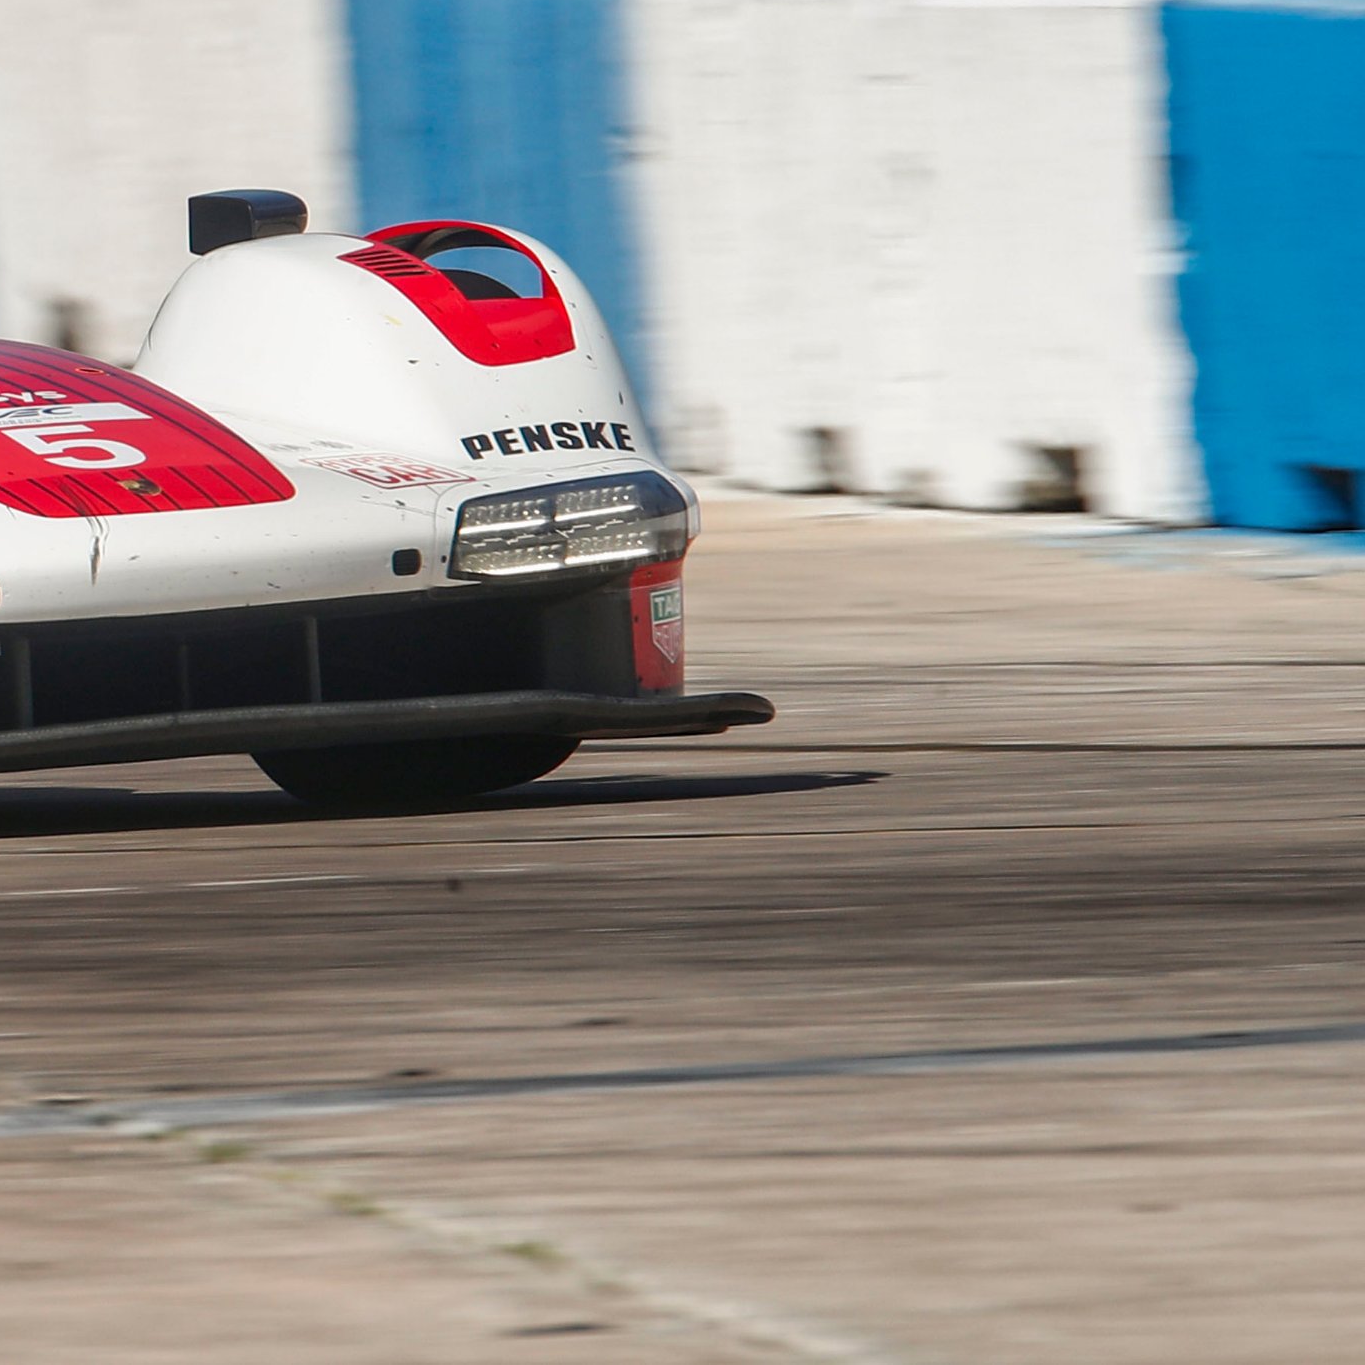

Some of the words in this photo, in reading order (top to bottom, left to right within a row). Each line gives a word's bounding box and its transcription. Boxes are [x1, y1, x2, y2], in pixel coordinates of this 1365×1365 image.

[0, 424, 146, 469] 5
[459, 420, 635, 461] PENSKE
[348, 463, 461, 484] CAR
